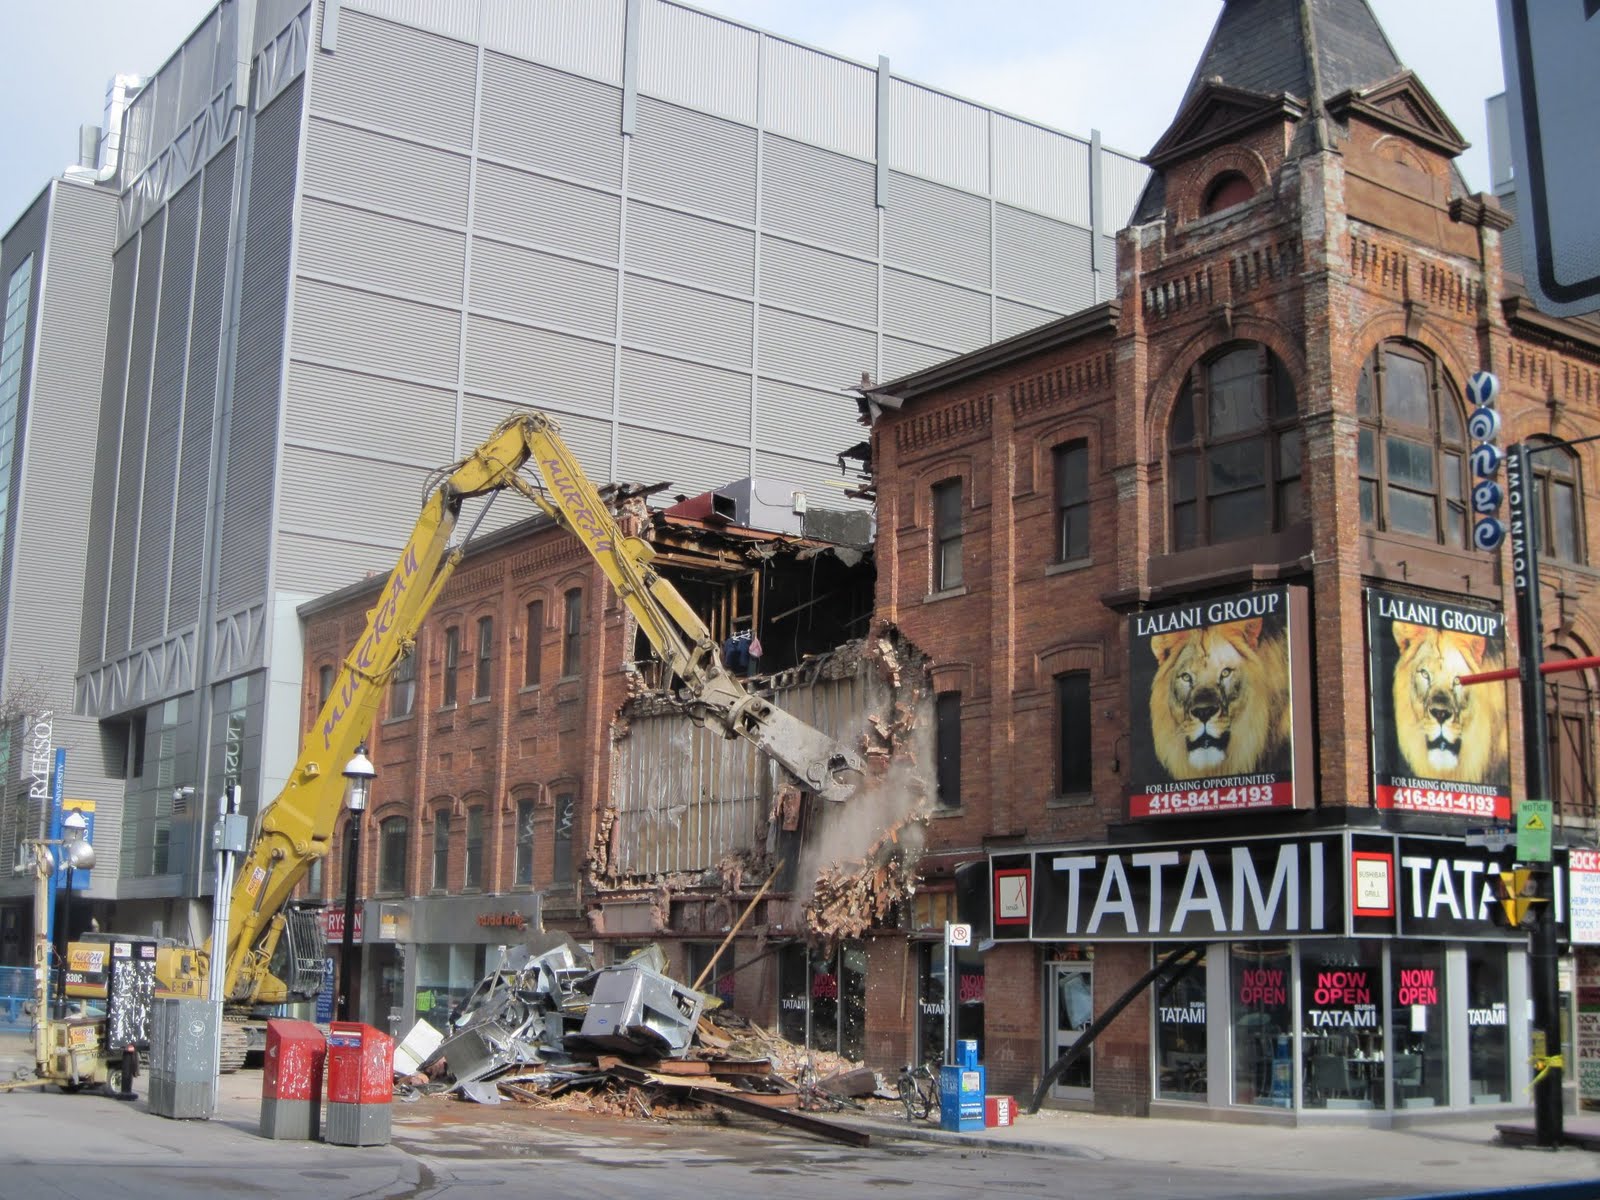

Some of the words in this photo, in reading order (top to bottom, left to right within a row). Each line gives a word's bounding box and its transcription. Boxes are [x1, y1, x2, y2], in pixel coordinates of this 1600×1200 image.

[542, 458, 612, 554] MURRAY
[1507, 455, 1527, 588] DOWNTOWN
[1137, 607, 1202, 637] LALANI
[1208, 593, 1279, 623] GROUP
[1378, 597, 1438, 626] LALANI
[1441, 609, 1497, 636] GROUP
[30, 711, 53, 798] RYERSON
[55, 764, 64, 807] UNIVERSITY
[1145, 785, 1163, 794] FOR
[1165, 780, 1201, 792] LEASING
[1203, 773, 1276, 790] OPPORTUNITIES
[1391, 776, 1407, 787] FOR
[1408, 778, 1439, 791] LEASING
[1440, 781, 1498, 796] OPPORTUNITIES
[1149, 785, 1273, 809] 416-841-4193
[1393, 788, 1494, 812] 416-841-4193
[1522, 803, 1547, 812] NOTICE
[1569, 850, 1596, 869] ROCK
[1053, 842, 1324, 934] TATAMI
[1402, 857, 1564, 923] TATAI
[329, 913, 361, 930] RYSN
[66, 973, 82, 983] 330C
[1243, 969, 1284, 987] NOW
[1318, 972, 1367, 989] NOW
[1400, 969, 1435, 988] NOW
[782, 999, 808, 1010] TATAMI
[1240, 987, 1287, 1005] OPEN
[1314, 988, 1370, 1006] OPEN
[1399, 987, 1437, 1006] OPEN
[1159, 1007, 1206, 1024] TATAMI
[1308, 1010, 1377, 1027] TATAMI
[1467, 1009, 1506, 1025] TATAMI
[999, 1101, 1009, 1125] SUN
